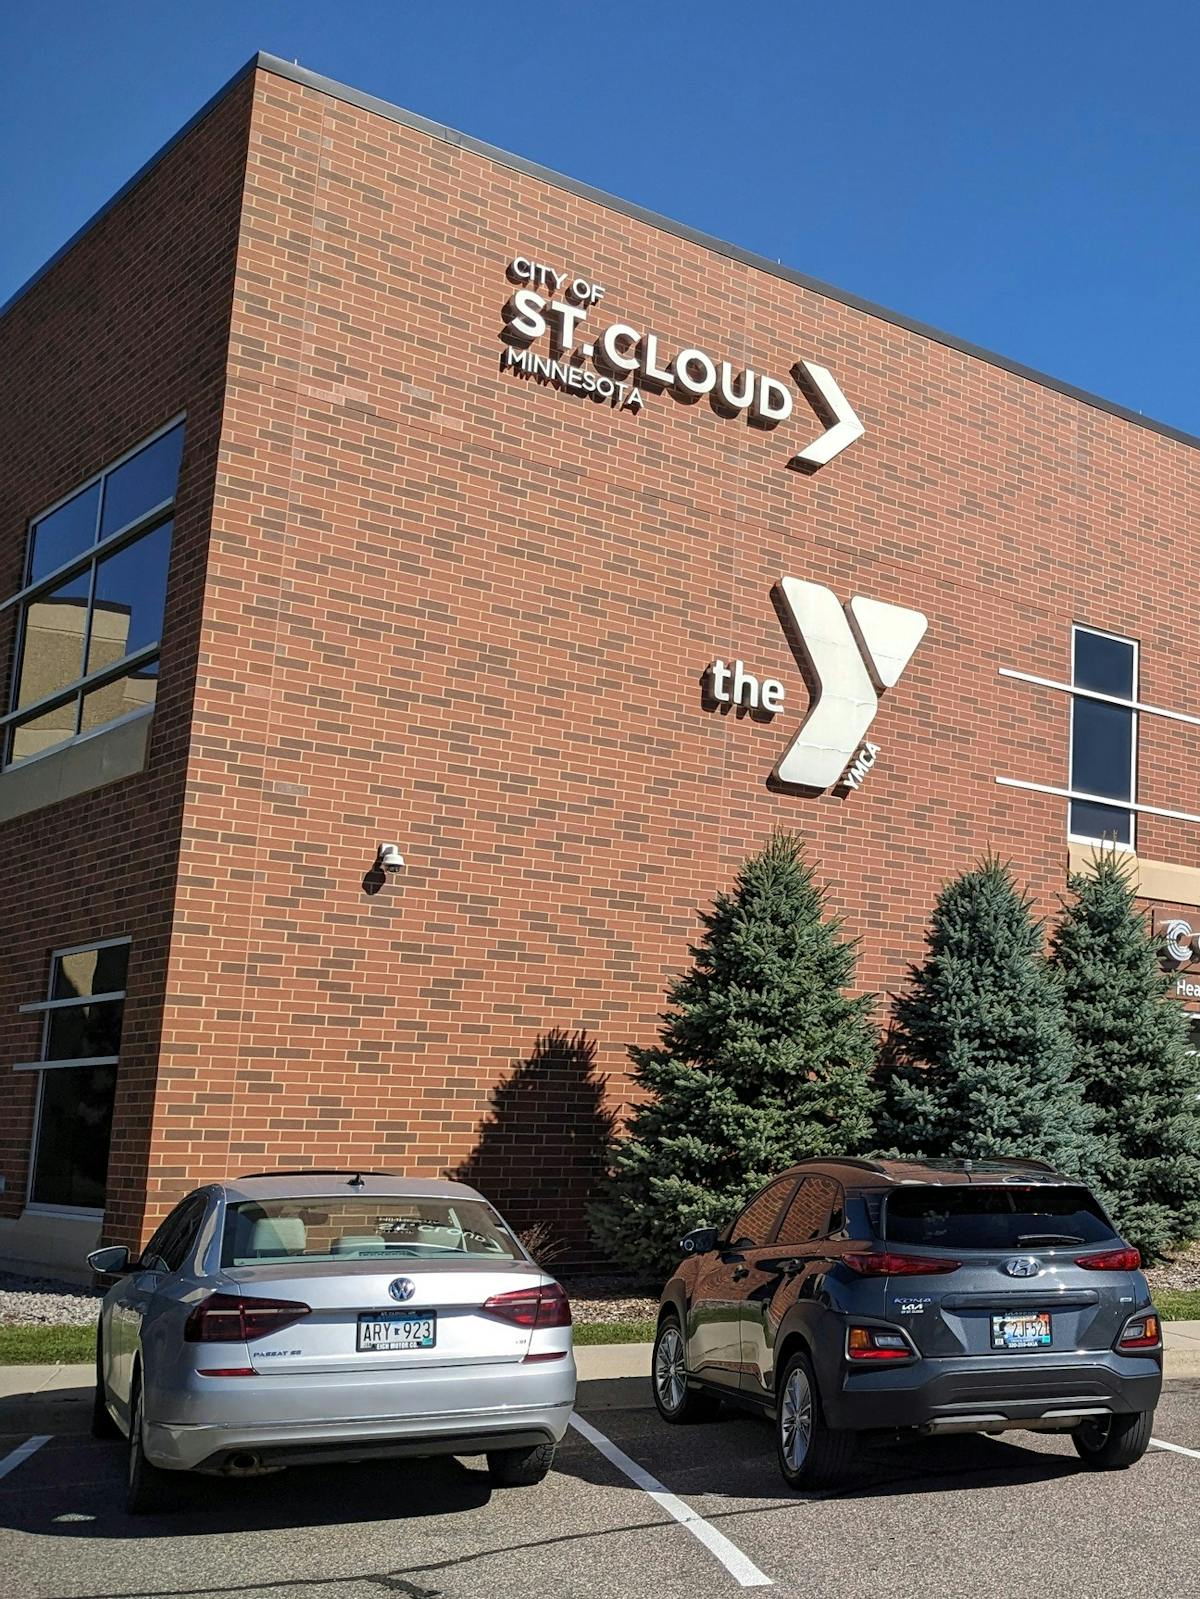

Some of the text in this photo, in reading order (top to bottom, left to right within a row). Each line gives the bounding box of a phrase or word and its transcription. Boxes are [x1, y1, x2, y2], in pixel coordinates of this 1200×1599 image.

[513, 256, 606, 301] CITY OF
[507, 346, 644, 409] MINNESOTA
[712, 659, 786, 713] the
[843, 742, 882, 791] YMCA
[253, 1350, 289, 1358] PASSAT
[363, 1321, 431, 1342] ARY 923
